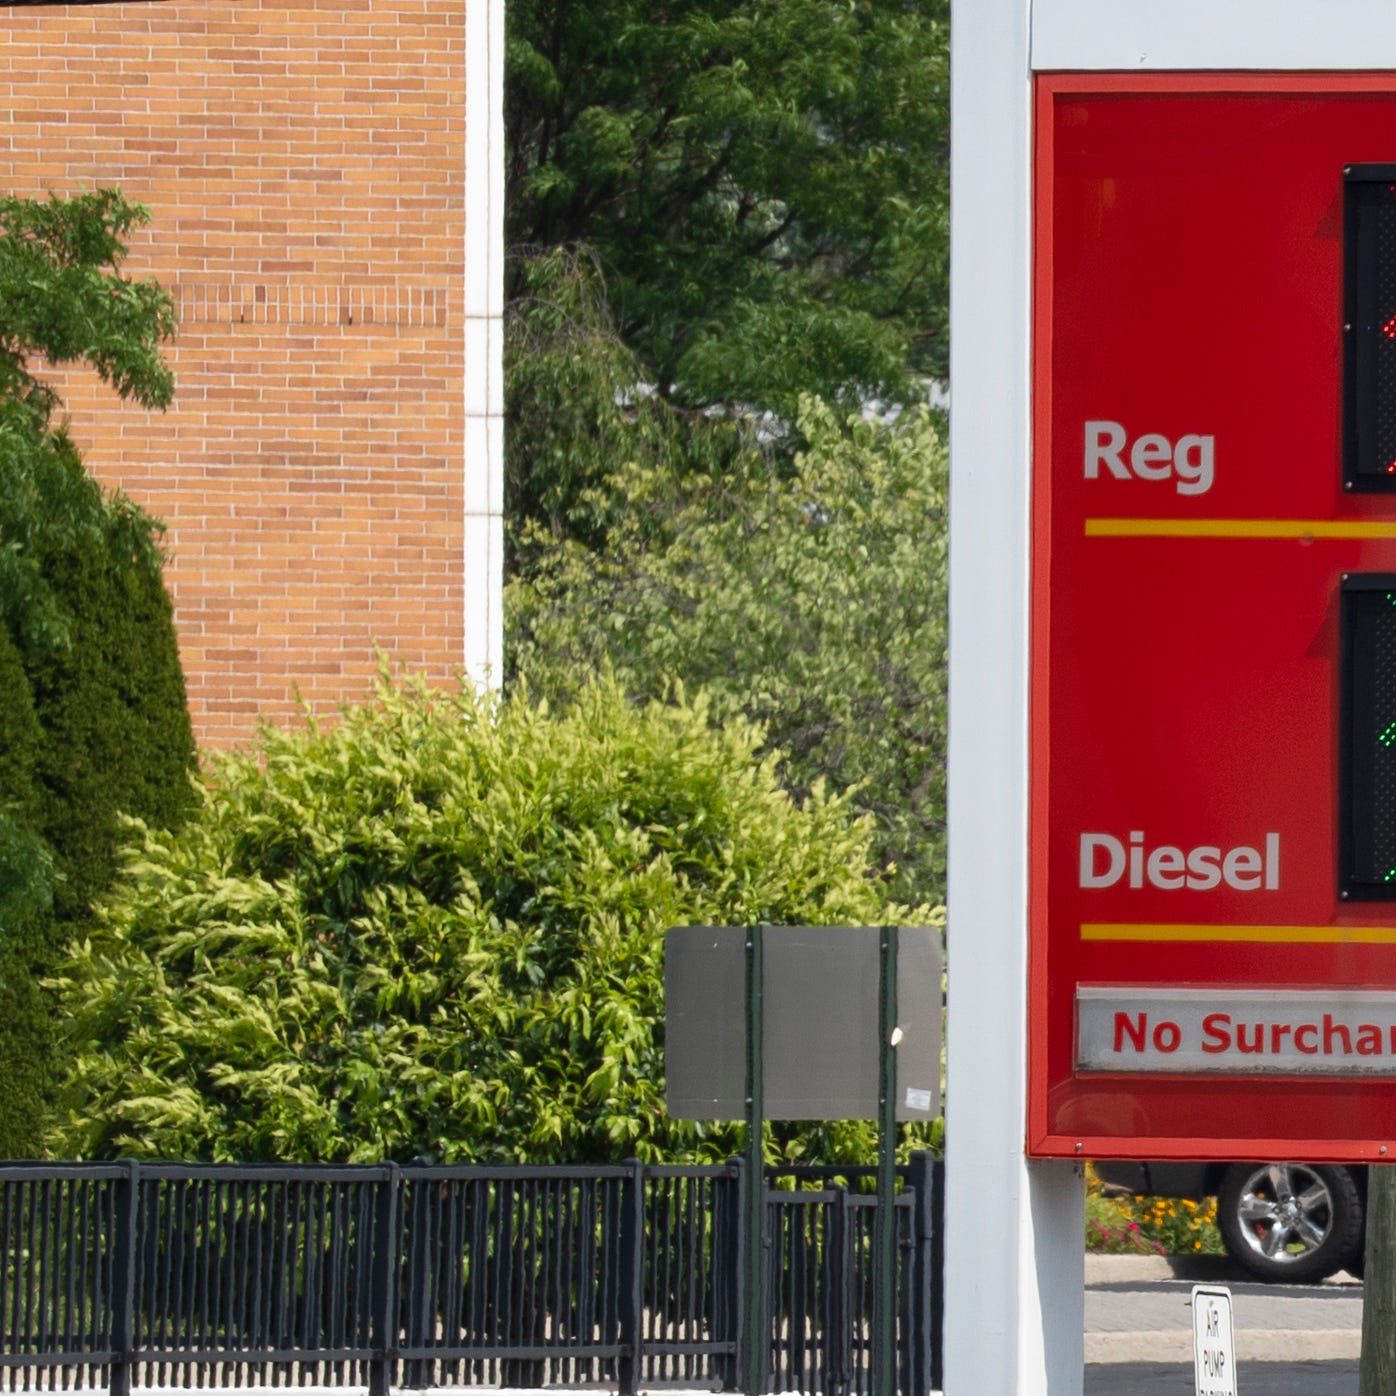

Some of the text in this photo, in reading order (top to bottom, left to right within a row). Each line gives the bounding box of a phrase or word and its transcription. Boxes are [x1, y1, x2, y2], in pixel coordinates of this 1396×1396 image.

[1083, 420, 1215, 494] Reg
[1078, 831, 1281, 892] Diesel
[1113, 1012, 1182, 1056] No
[1207, 1310, 1219, 1337] AIR
[1204, 1350, 1225, 1377] PUMP
